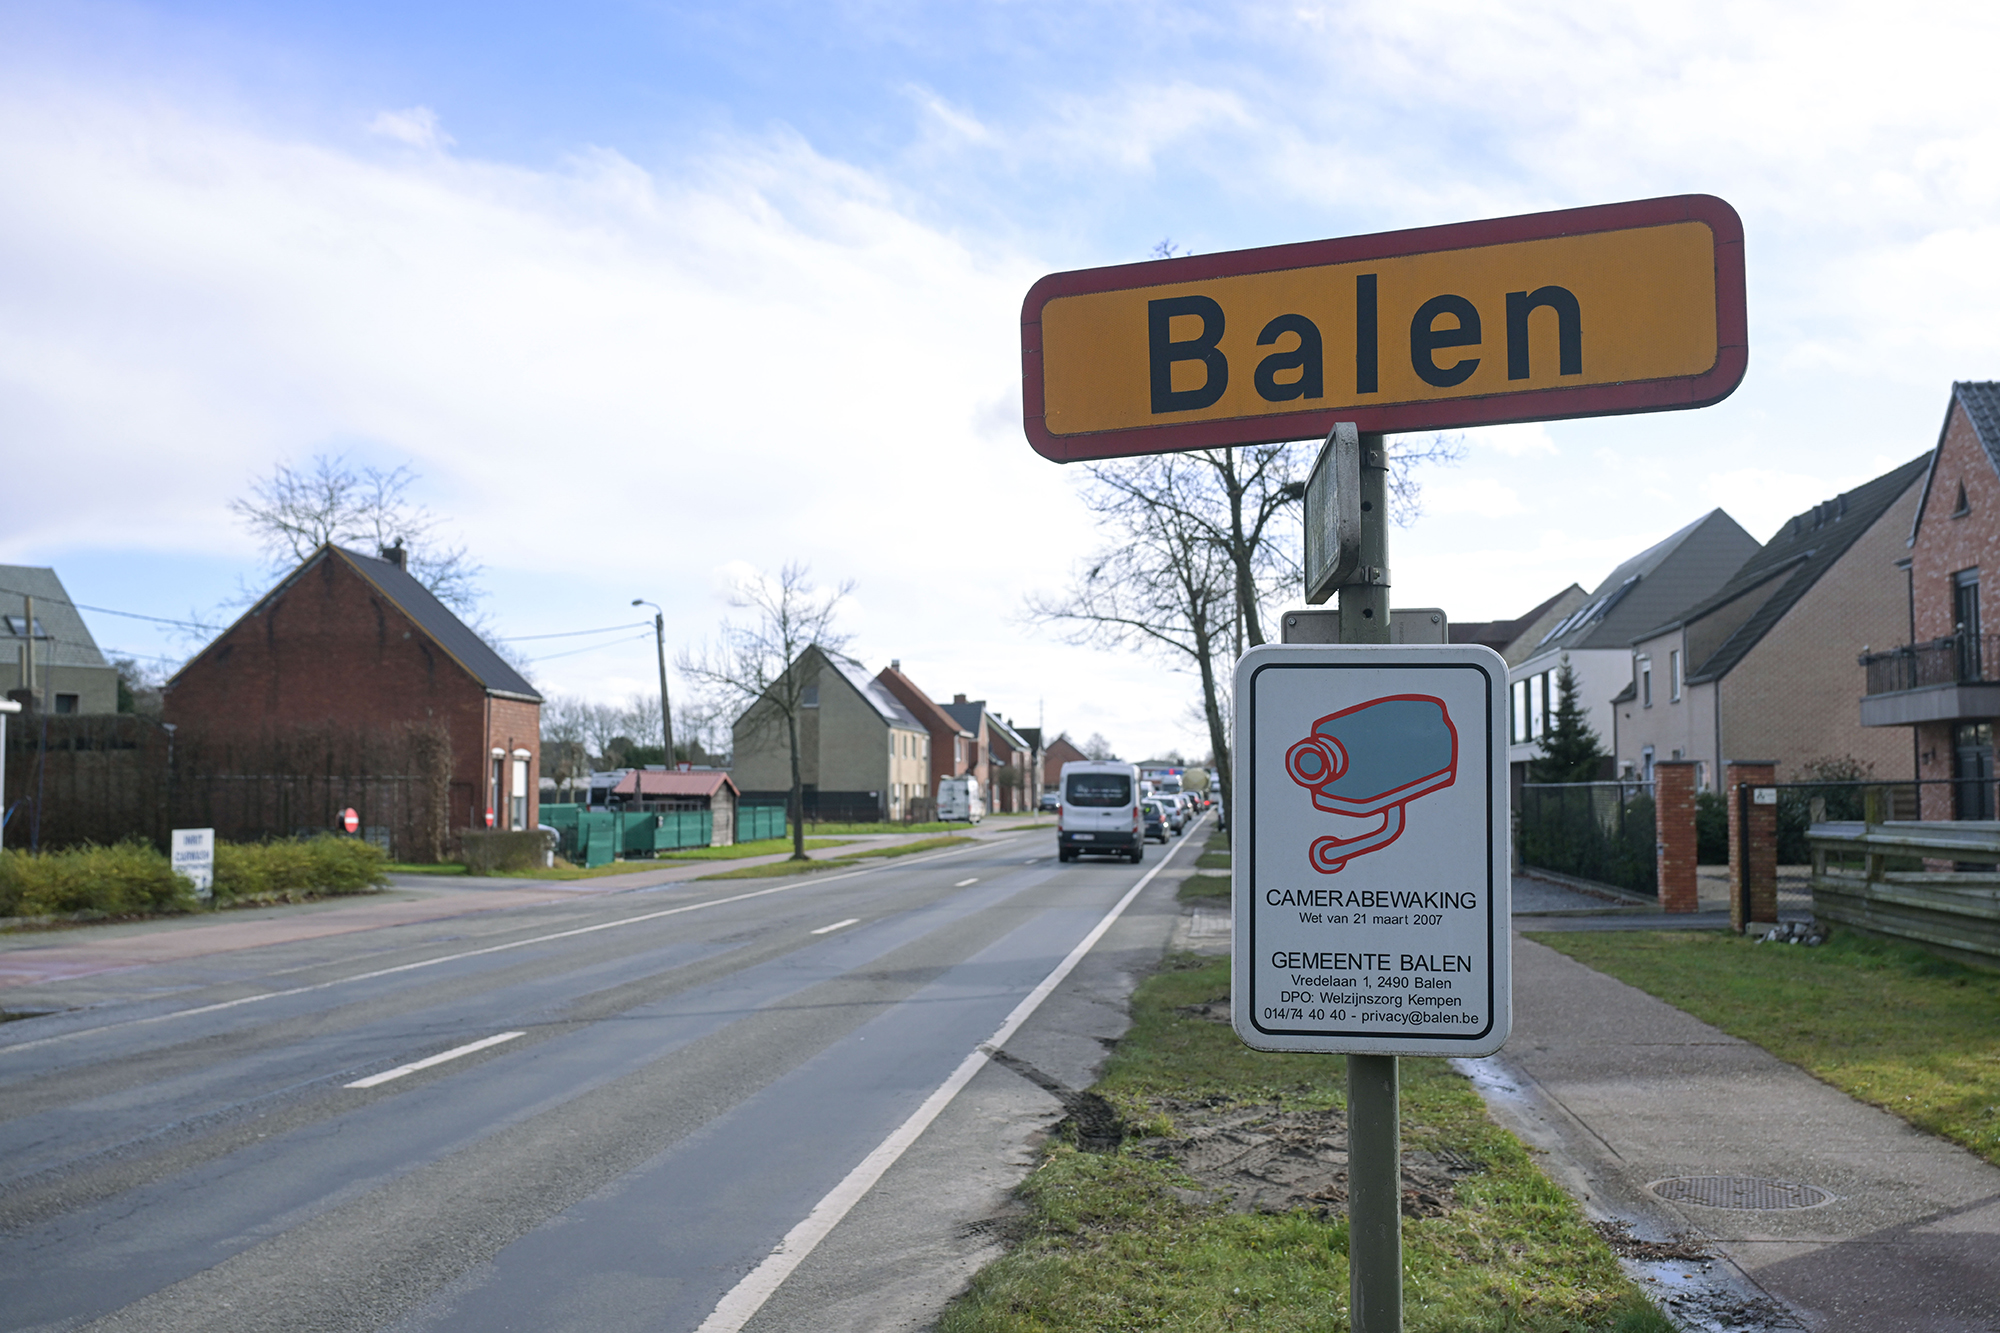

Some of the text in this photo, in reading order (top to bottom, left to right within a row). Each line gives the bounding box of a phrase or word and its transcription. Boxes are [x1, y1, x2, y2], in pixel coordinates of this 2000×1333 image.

[1147, 273, 1583, 414] Balen
[1266, 888, 1477, 910] CAMERABEWAKING
[1298, 911, 1443, 926] Wet van 21 maart 2007
[1271, 951, 1472, 973] GEMEENTE BALEN
[1290, 973, 1452, 990] Vredelaan 1, 2490 Balen
[1280, 990, 1462, 1009] DPO: Welzijnszorg Kempen
[1263, 1007, 1304, 1021] 014/74
[1308, 1008, 1325, 1021] 40
[1329, 1008, 1347, 1022] 40
[1361, 1010, 1480, 1026] privacy@balen.be
